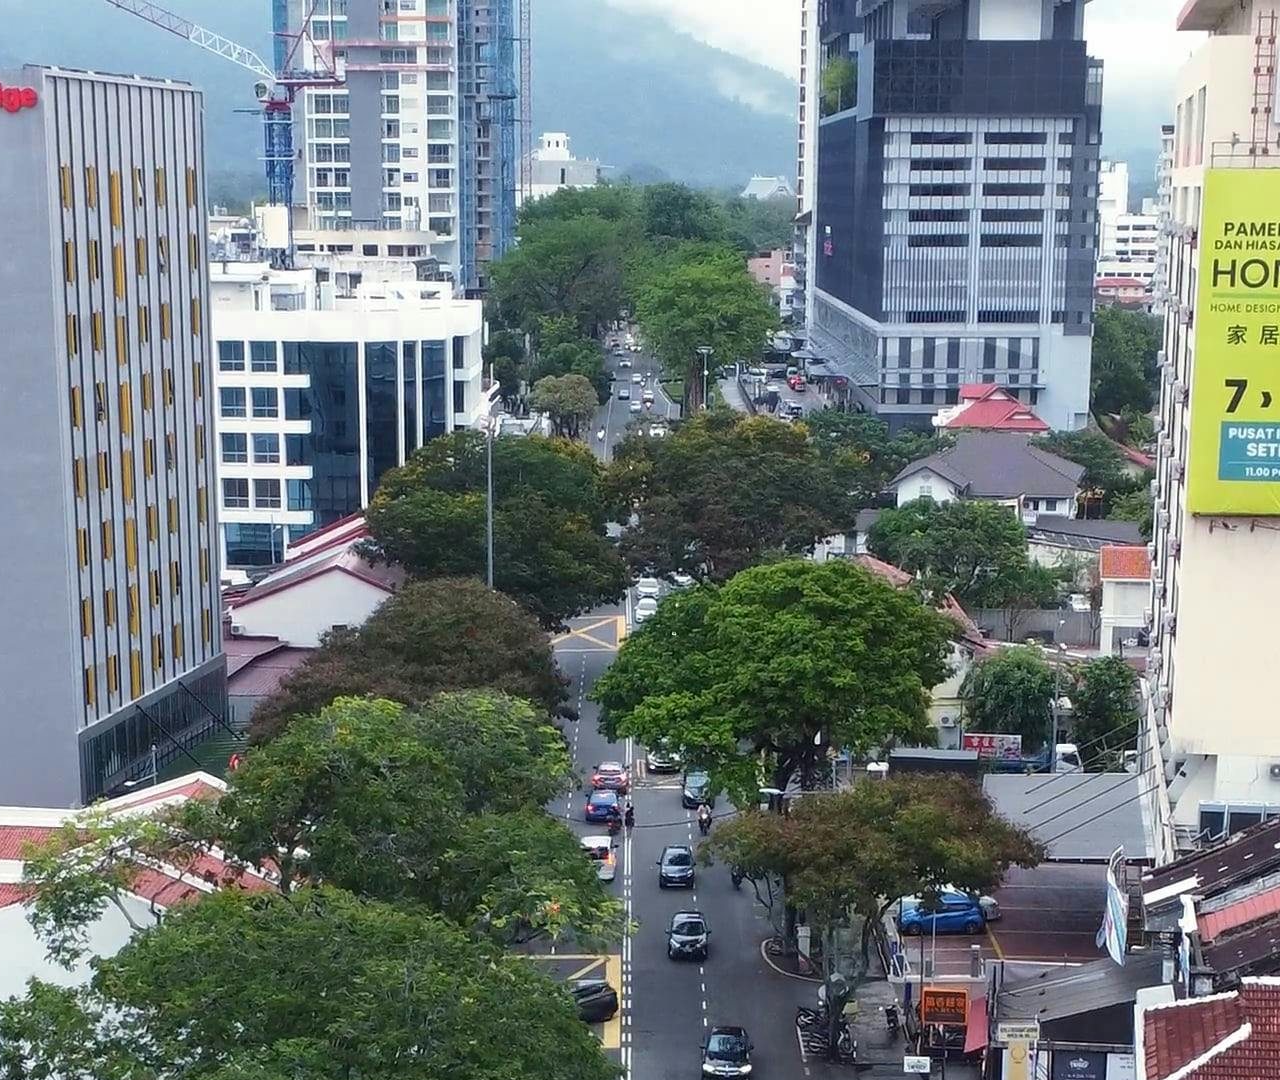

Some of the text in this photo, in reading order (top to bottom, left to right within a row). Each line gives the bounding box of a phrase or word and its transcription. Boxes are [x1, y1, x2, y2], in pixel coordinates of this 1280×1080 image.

[1214, 240, 1243, 250] DAN
[1210, 304, 1242, 313] HOME
[1224, 379, 1248, 413] 7
[1228, 427, 1273, 440] PUSAT
[1245, 467, 1270, 477] 11.00
